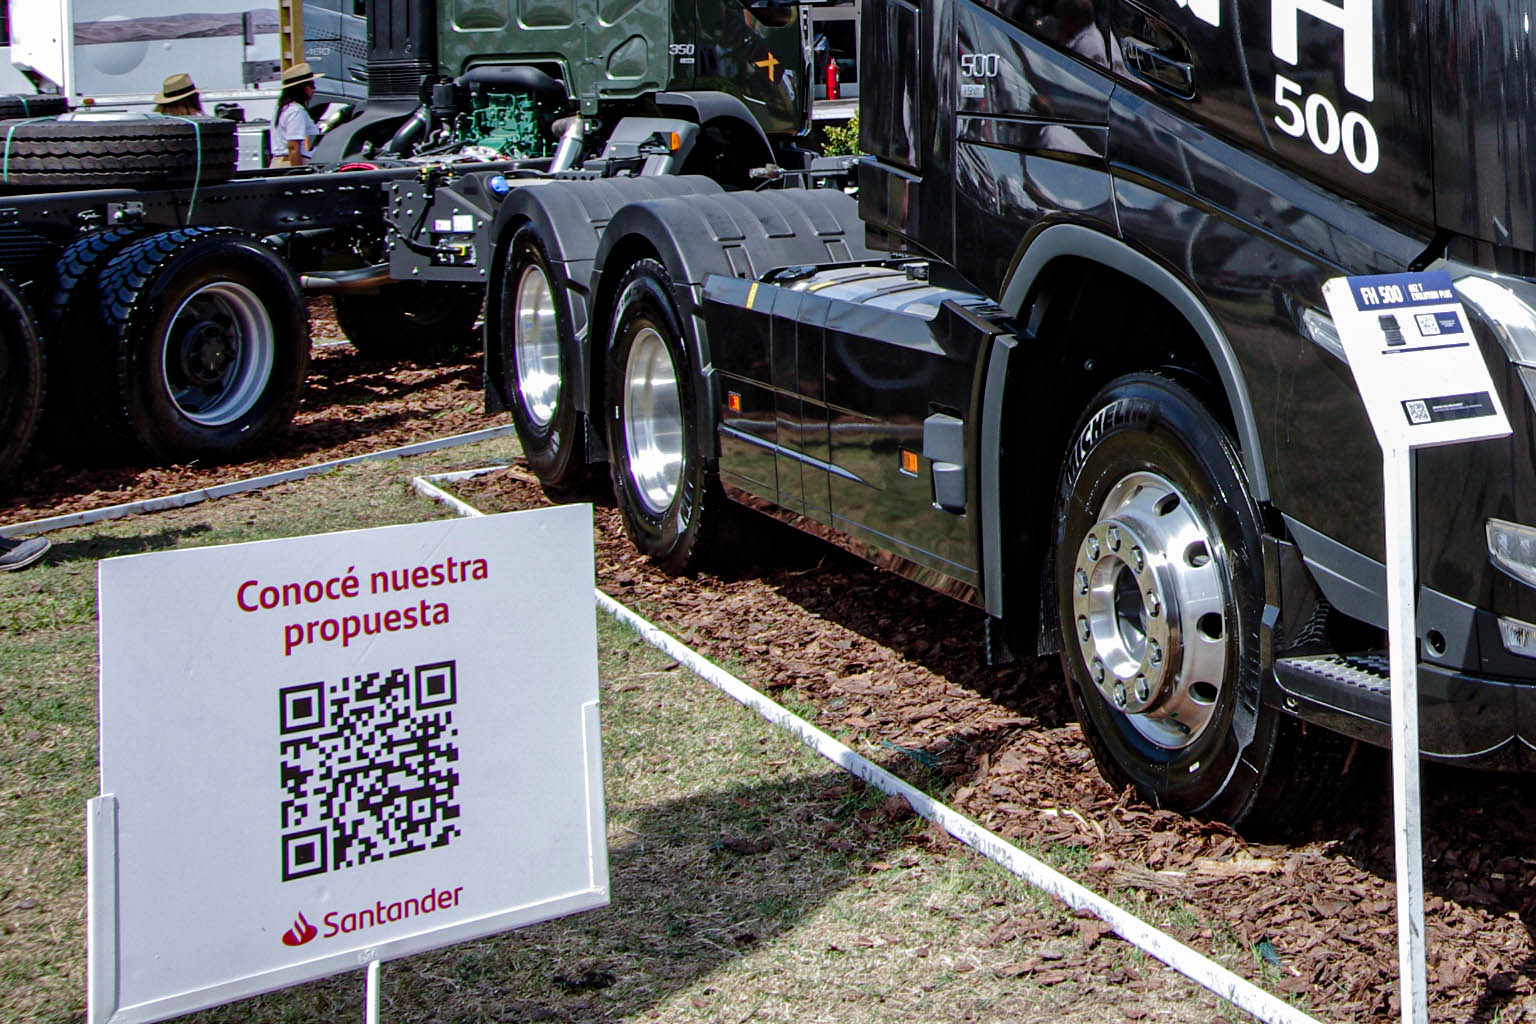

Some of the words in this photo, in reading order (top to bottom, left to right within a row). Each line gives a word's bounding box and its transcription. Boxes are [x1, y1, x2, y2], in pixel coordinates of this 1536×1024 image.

[669, 44, 695, 55] 350
[961, 53, 1000, 77] 500
[1274, 73, 1379, 174] 500
[1360, 287, 1380, 306] FH
[1378, 284, 1404, 304] 500
[237, 565, 360, 613] Conocé
[370, 556, 489, 595] nuestra
[284, 599, 450, 656] propuesta
[323, 886, 464, 939] Santander
